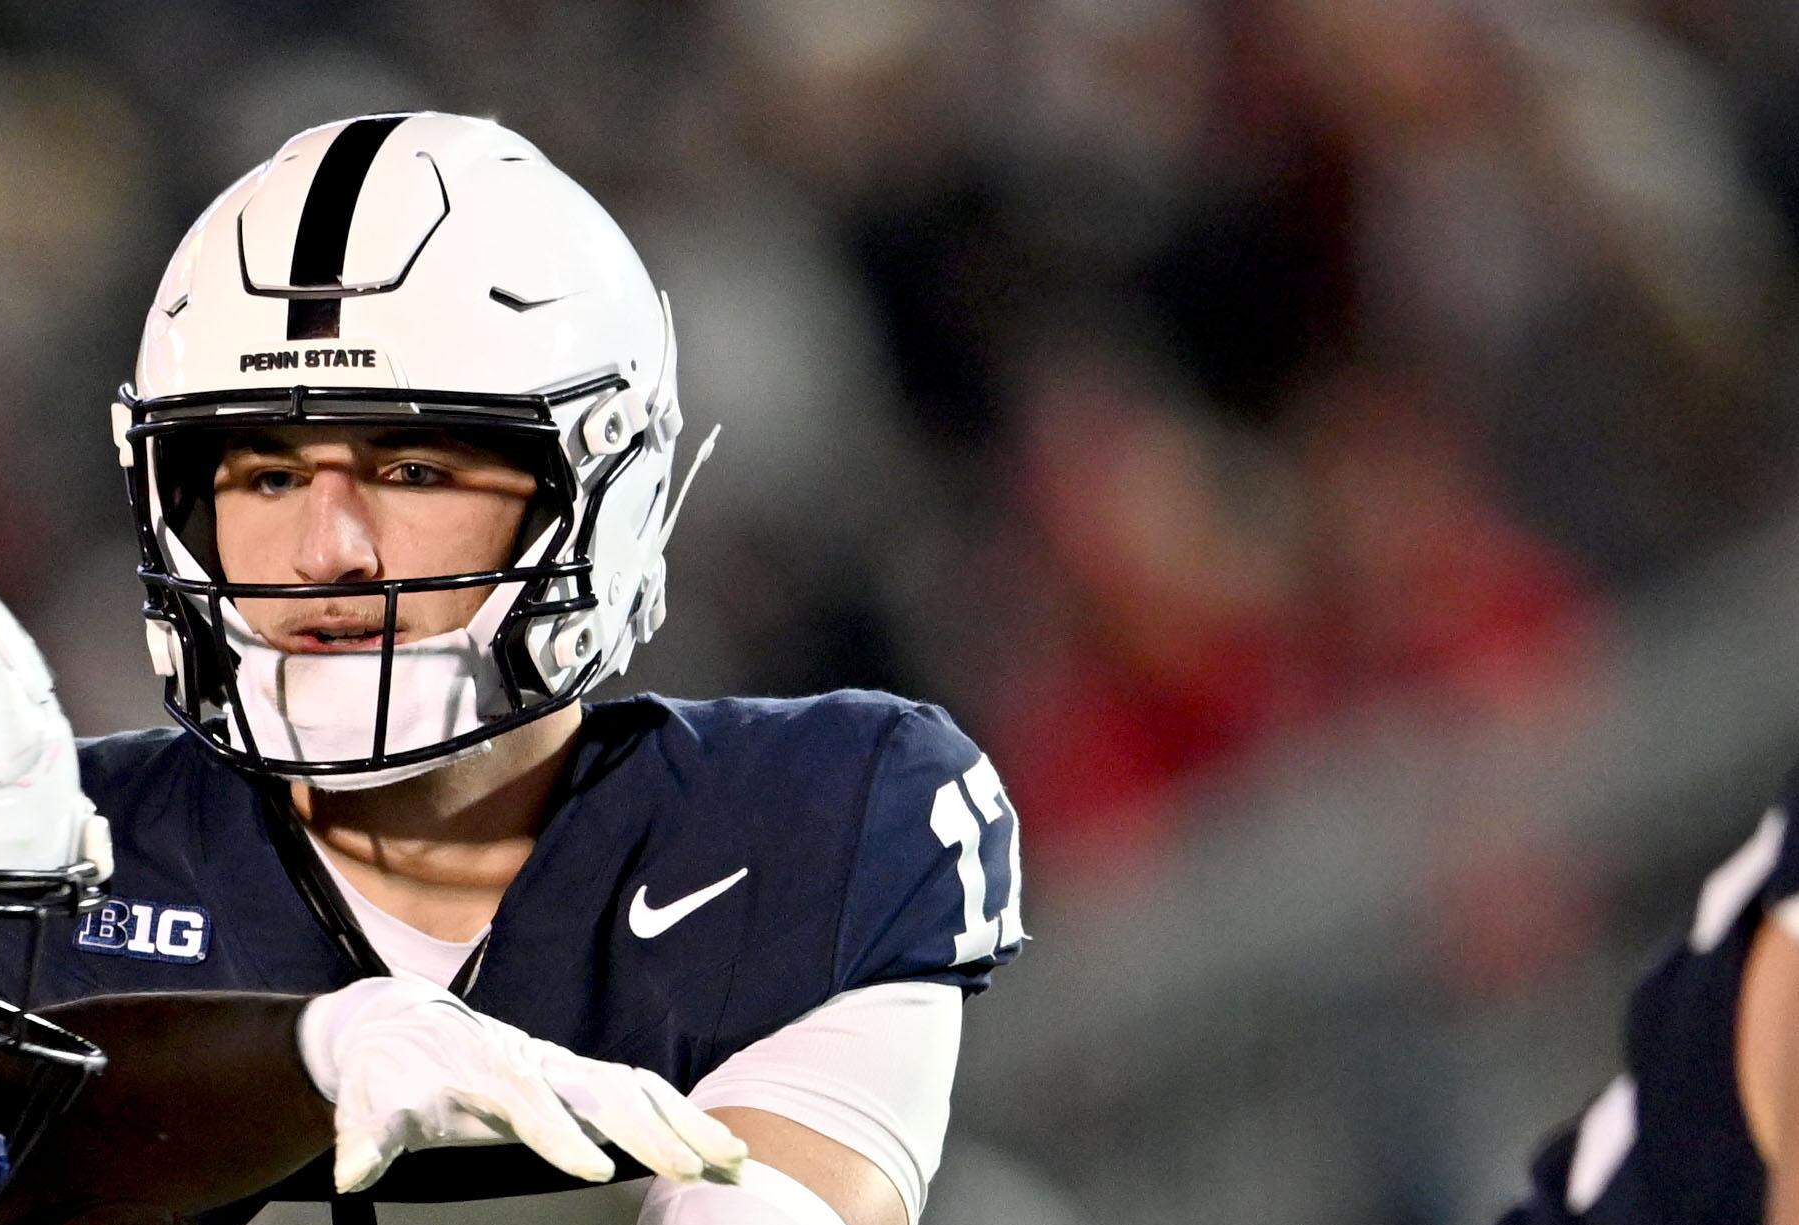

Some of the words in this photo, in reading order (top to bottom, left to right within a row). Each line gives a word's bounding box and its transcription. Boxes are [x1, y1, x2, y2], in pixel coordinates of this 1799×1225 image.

[240, 351, 299, 372] PENN
[304, 349, 376, 367] STATE
[78, 899, 204, 958] BIG
